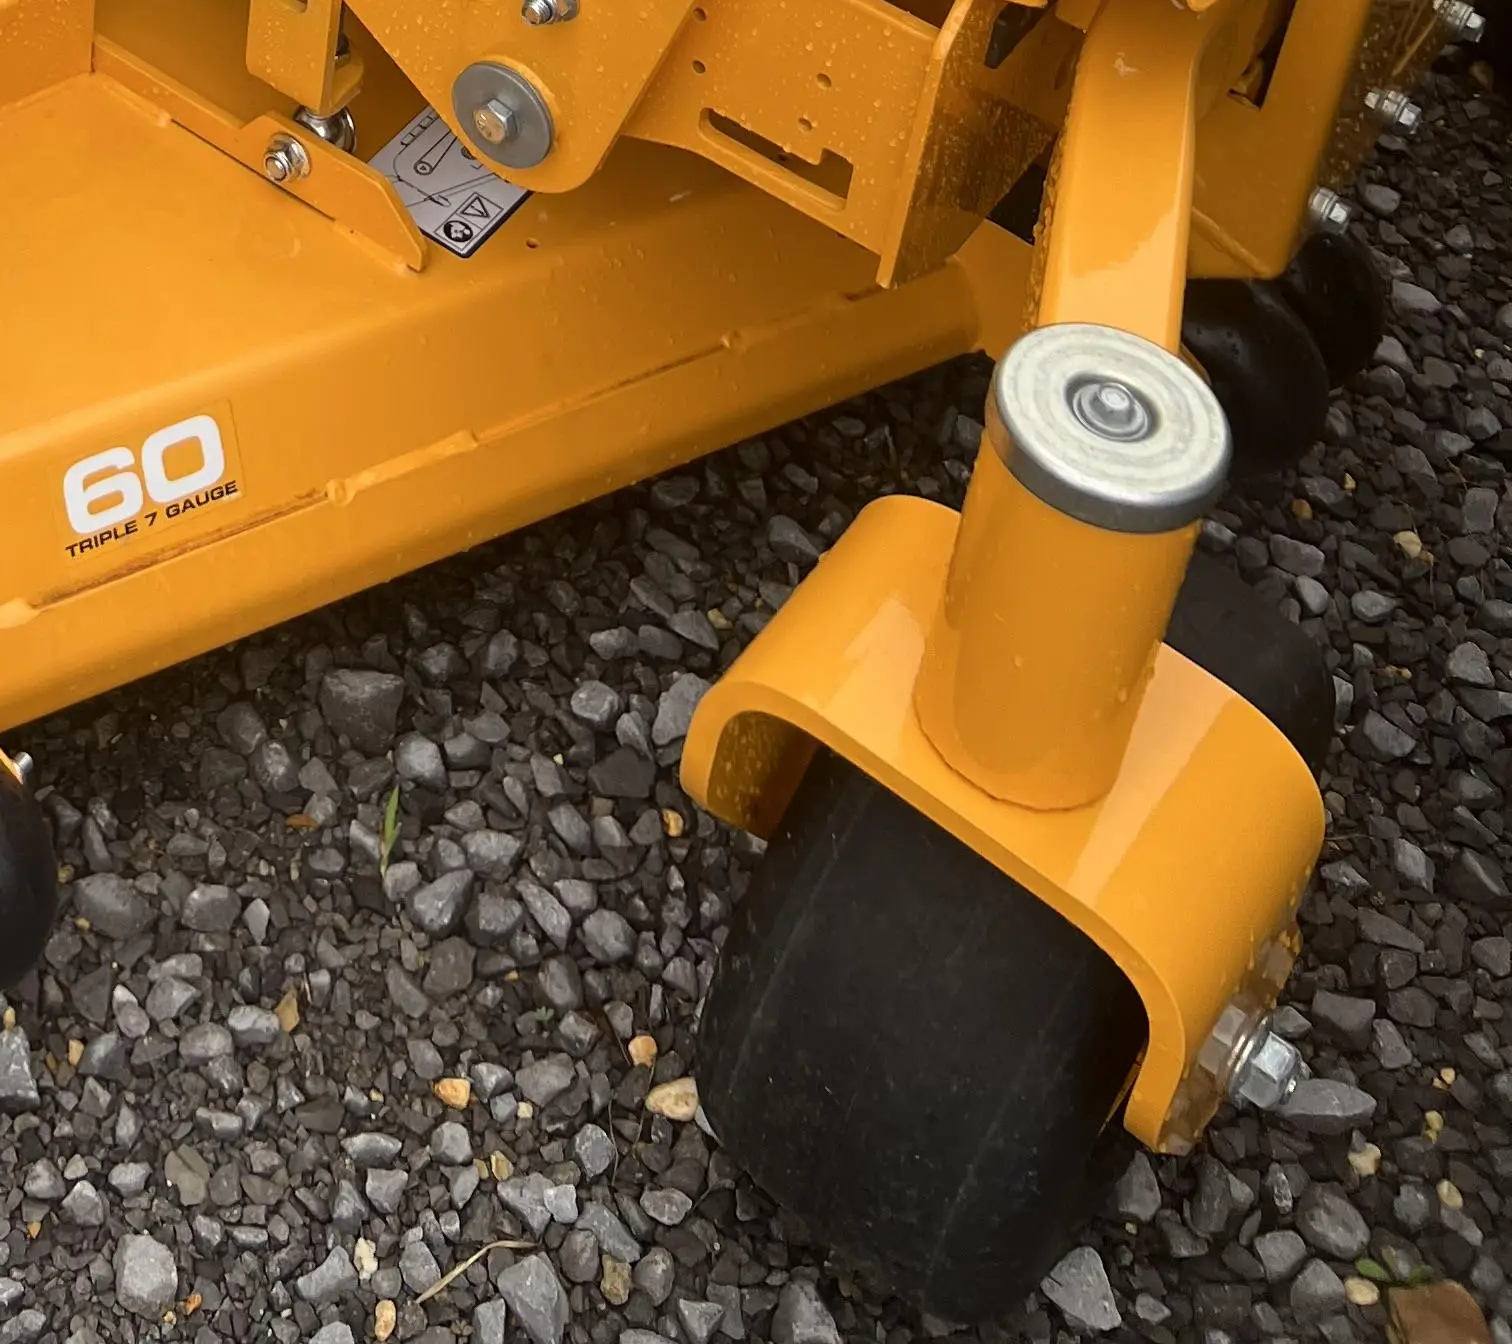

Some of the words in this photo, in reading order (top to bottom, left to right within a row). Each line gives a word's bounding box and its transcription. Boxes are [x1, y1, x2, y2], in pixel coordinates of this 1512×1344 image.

[63, 414, 226, 535] 60
[65, 520, 139, 558] TRIPLE
[144, 511, 159, 527] 7
[165, 480, 238, 520] GAUGE
